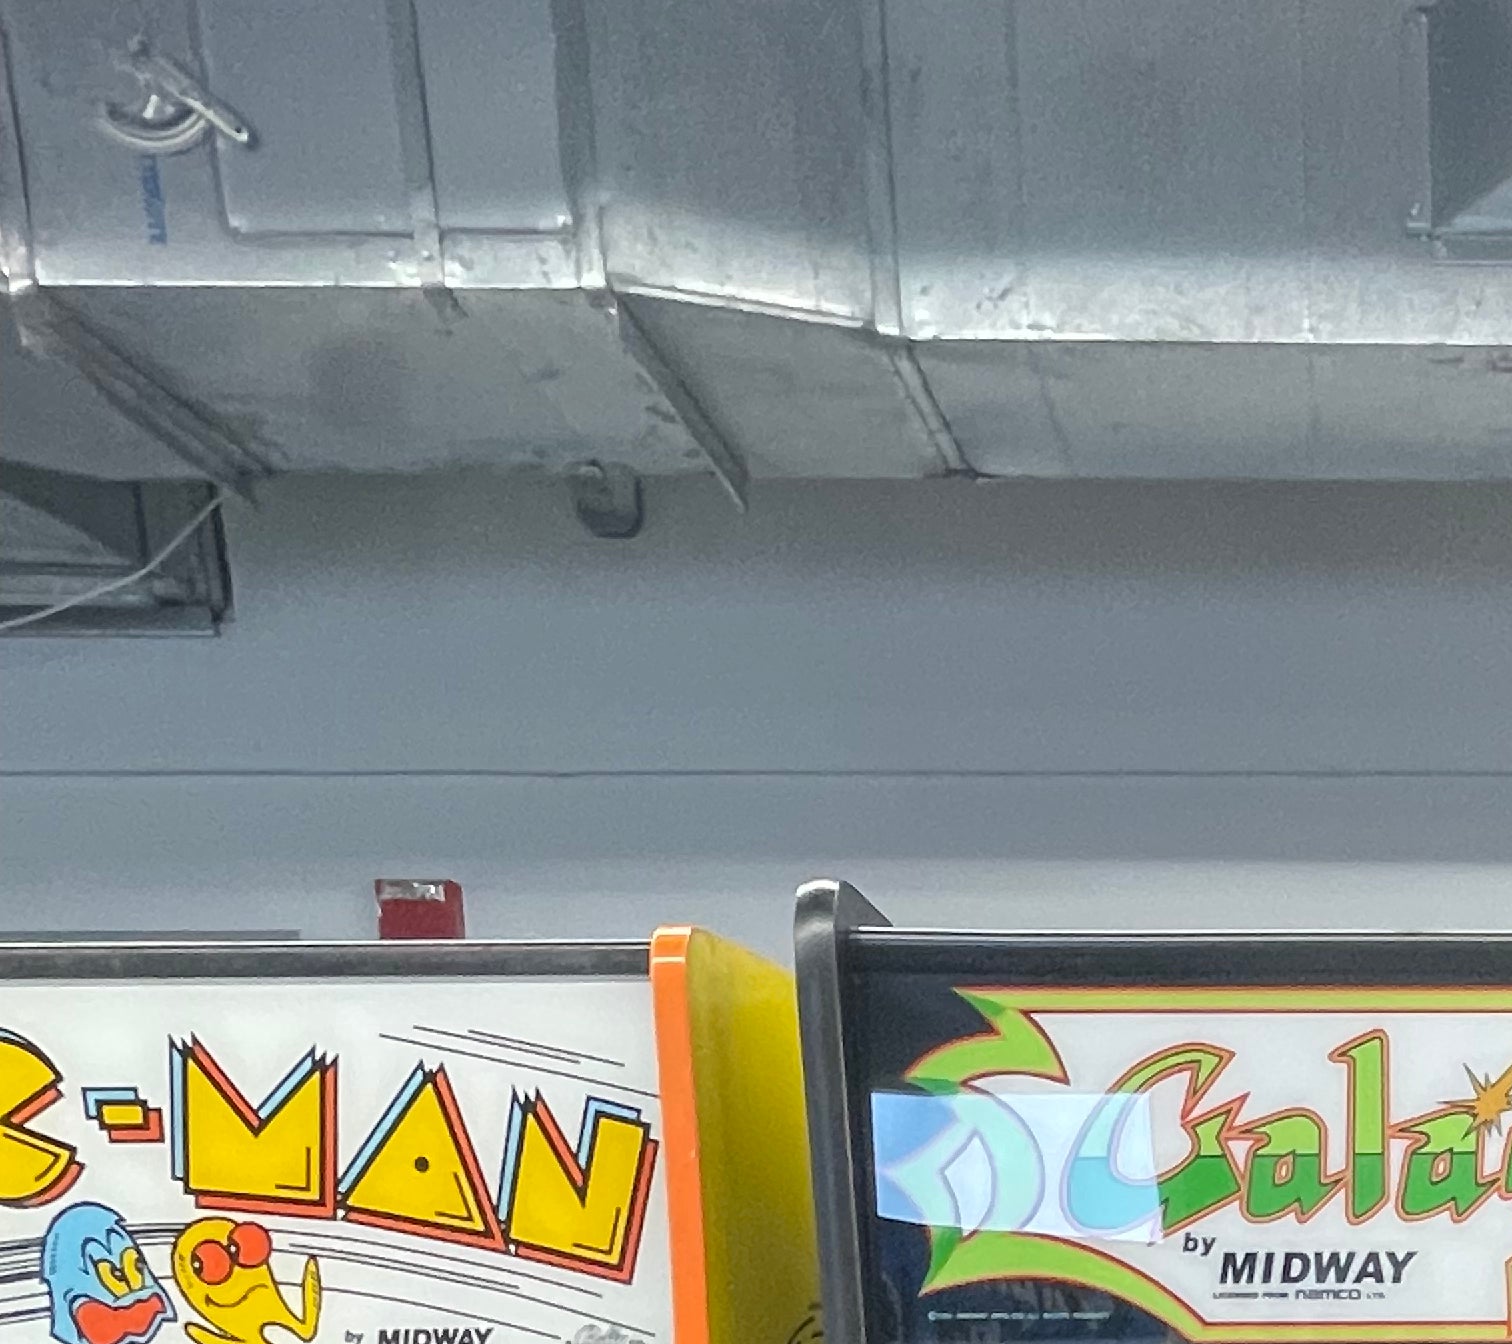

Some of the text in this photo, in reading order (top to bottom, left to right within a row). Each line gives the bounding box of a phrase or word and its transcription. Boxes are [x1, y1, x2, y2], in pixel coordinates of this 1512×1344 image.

[1182, 1231, 1217, 1256] by
[1219, 1250, 1419, 1285] MIDWAY
[344, 1331, 364, 1344] by
